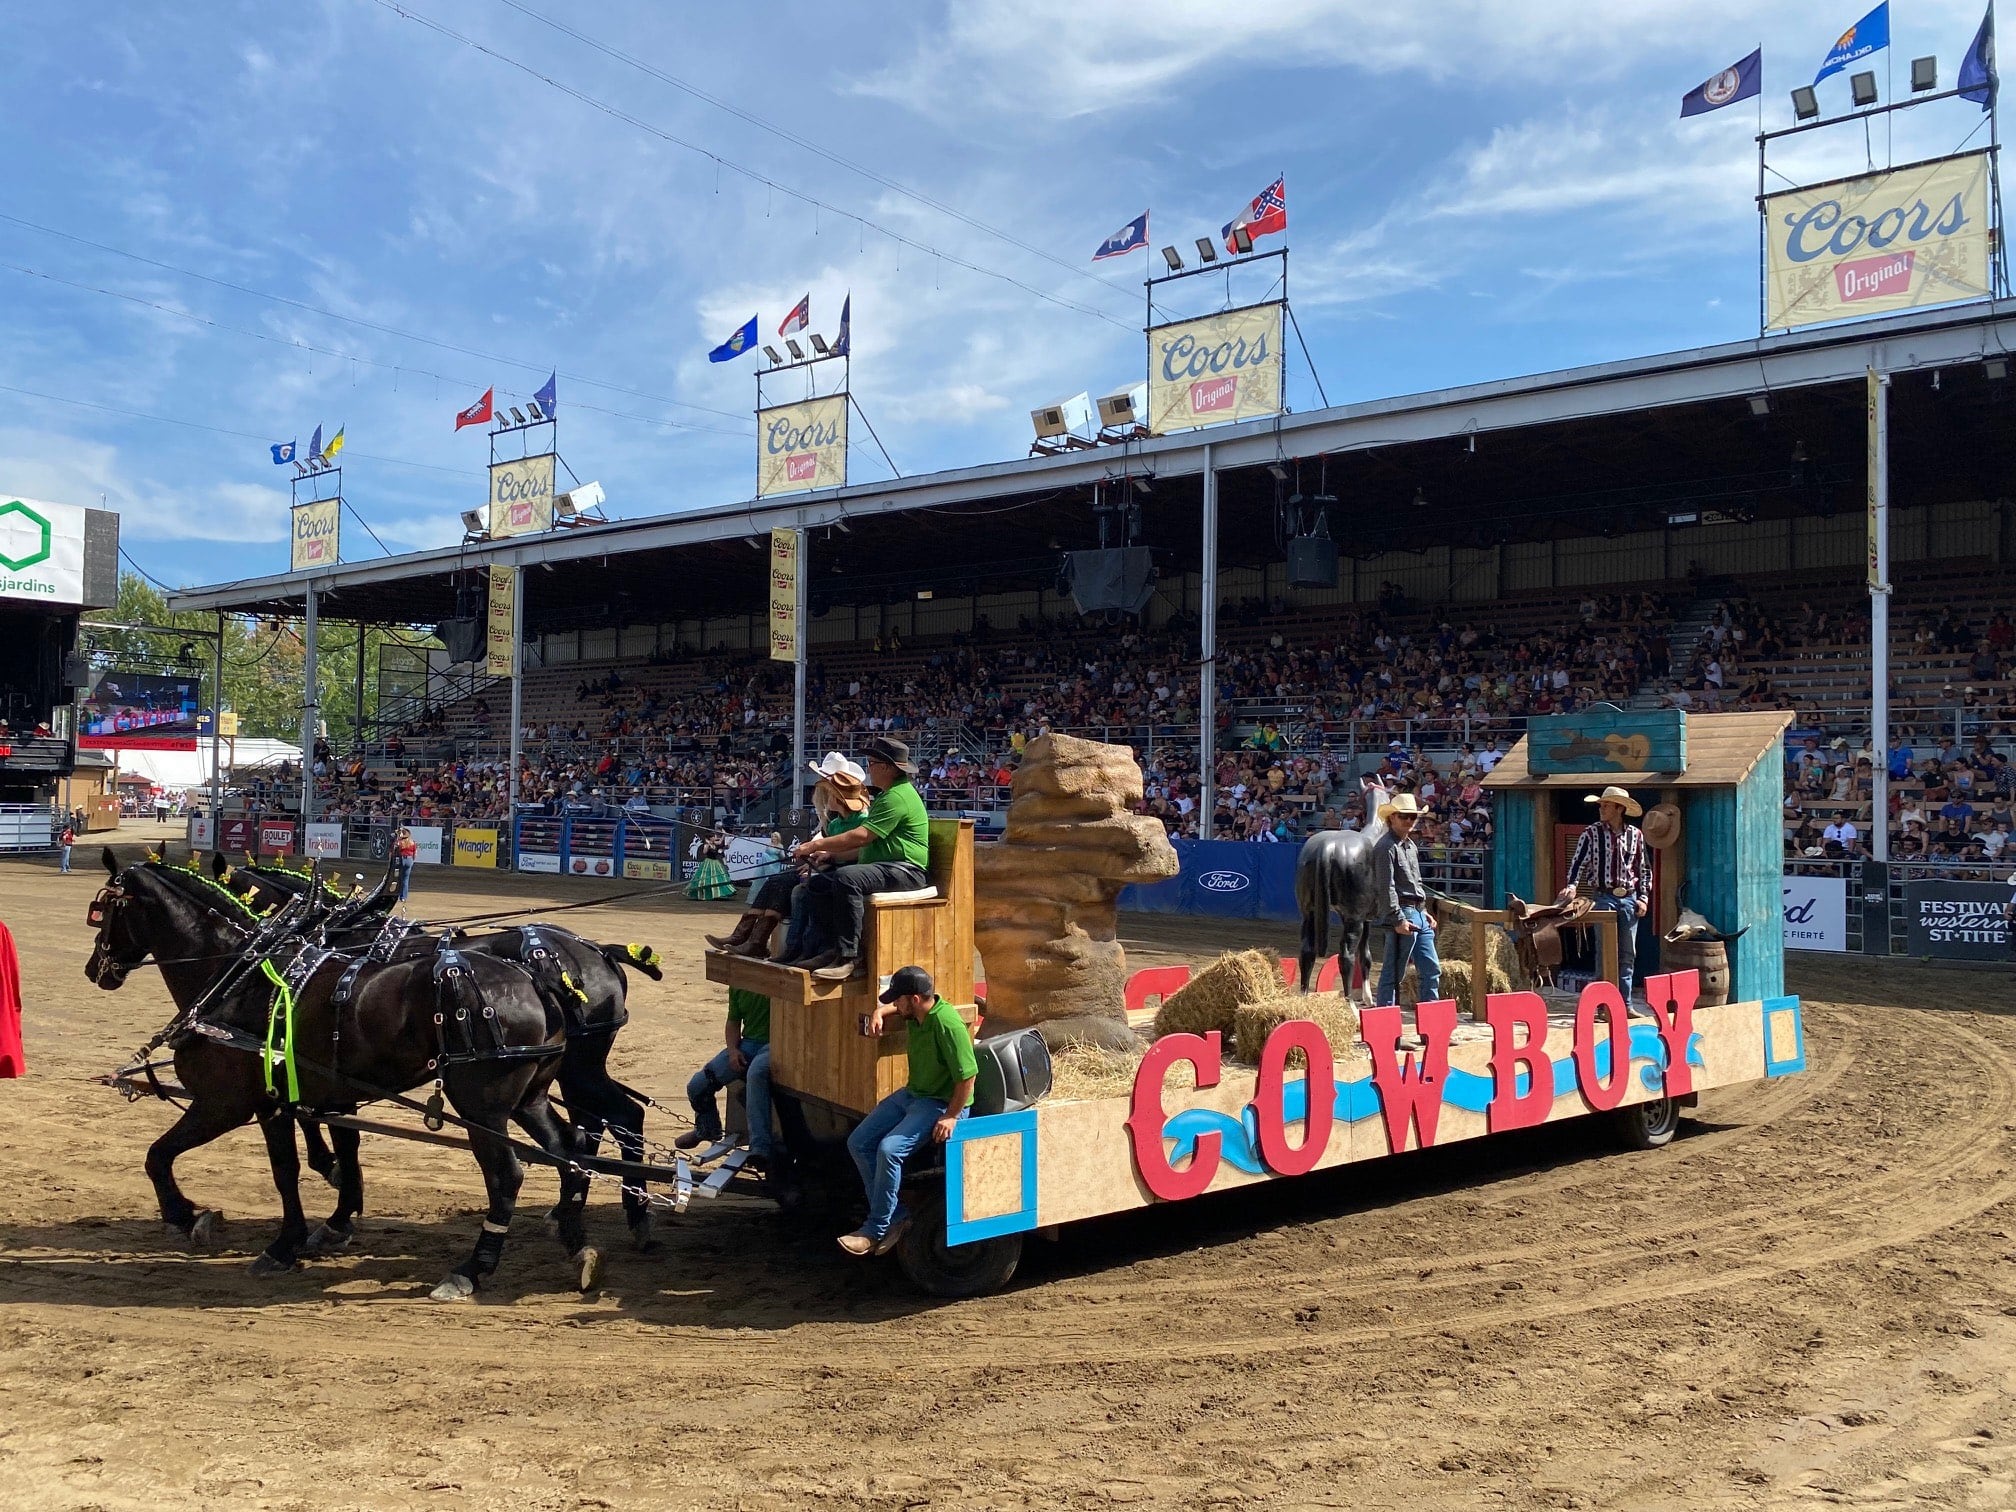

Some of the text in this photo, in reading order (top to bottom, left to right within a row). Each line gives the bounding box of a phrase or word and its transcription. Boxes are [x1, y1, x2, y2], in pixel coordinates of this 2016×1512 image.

[1785, 192, 1971, 262] Coors
[1844, 257, 1908, 296] Original
[1162, 332, 1269, 381] Coors
[1196, 380, 1234, 410] Original
[767, 417, 838, 454] Coors
[497, 472, 548, 503] Coors
[297, 513, 335, 539] Coors
[773, 538, 795, 551] Coors
[491, 573, 512, 584] Coors
[772, 568, 794, 581] Coors
[489, 599, 511, 610] Coors
[771, 599, 794, 612] Coors
[489, 625, 510, 636] Coors
[771, 630, 794, 642] Coors
[488, 651, 510, 662] Coors
[264, 830, 290, 841] BOULET
[416, 841, 439, 850] esjardins
[457, 838, 494, 859] Wrangler
[726, 851, 754, 865] uébec
[1208, 873, 1239, 889] Ford
[1919, 912, 2009, 929] western
[1791, 930, 1825, 940] FIERTÉ
[1126, 969, 1700, 1200] COWBOY
